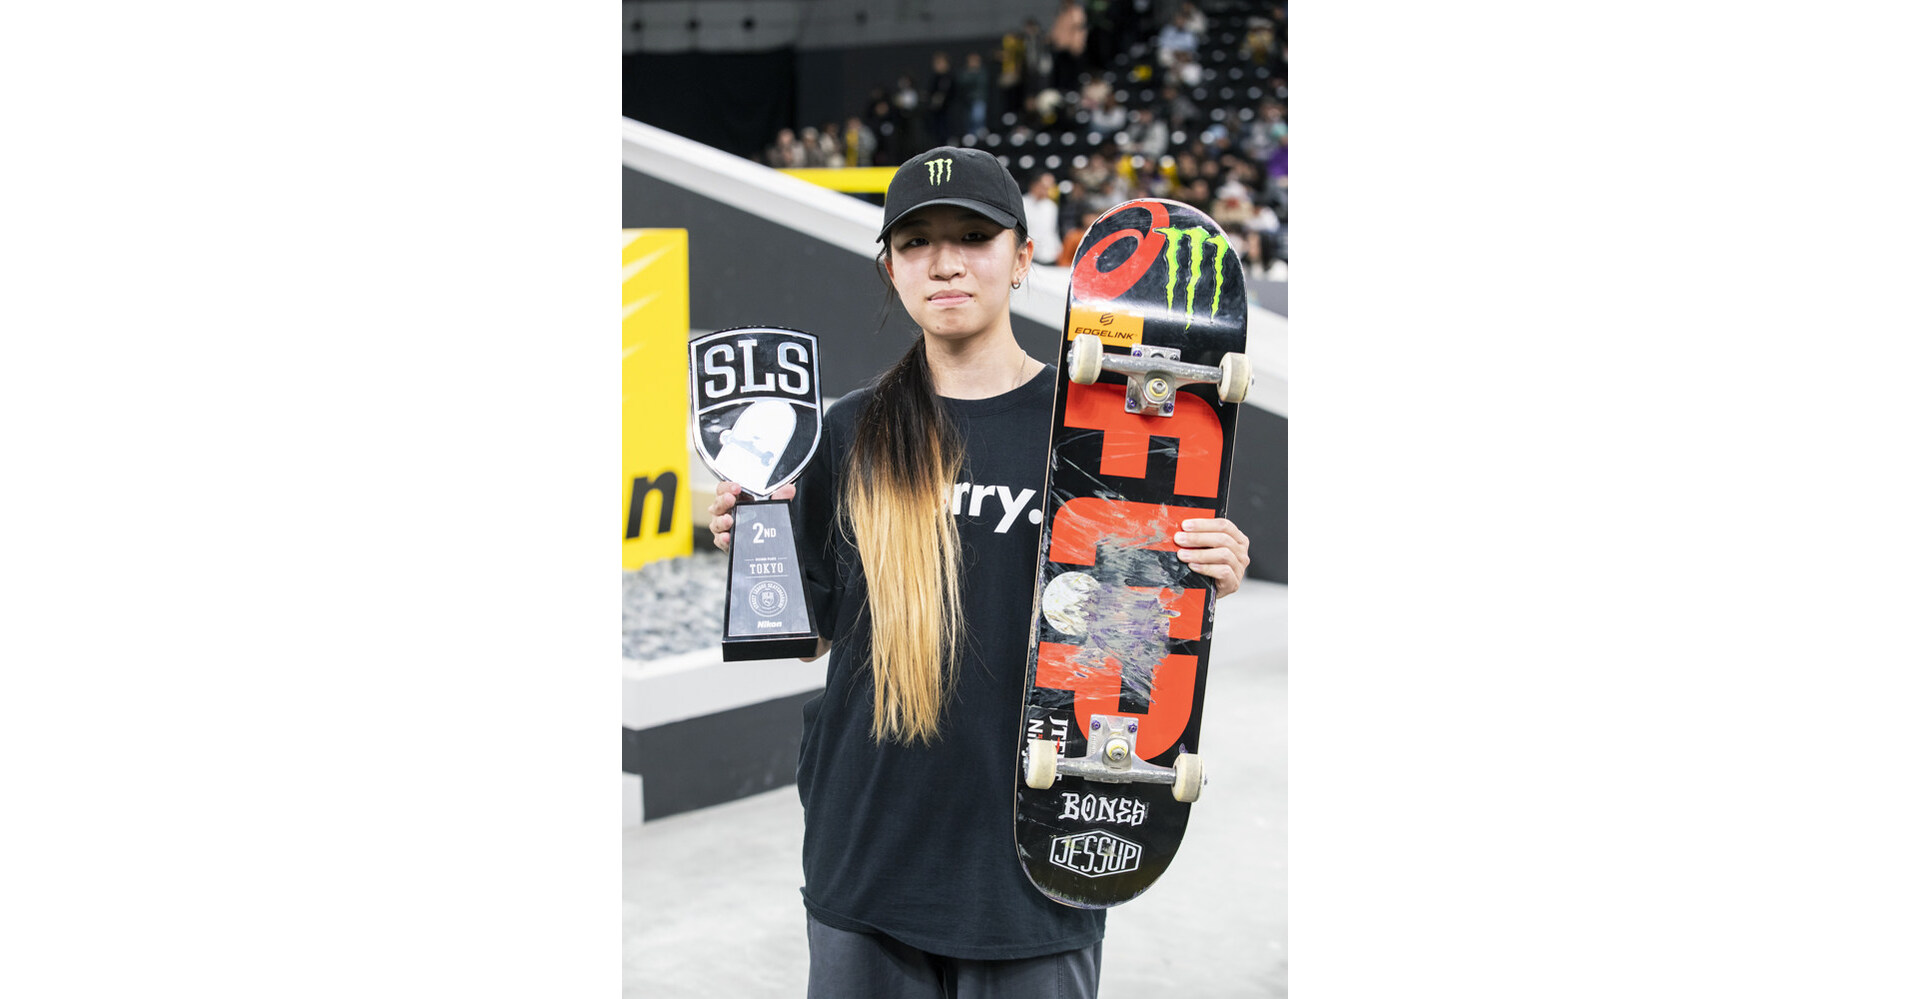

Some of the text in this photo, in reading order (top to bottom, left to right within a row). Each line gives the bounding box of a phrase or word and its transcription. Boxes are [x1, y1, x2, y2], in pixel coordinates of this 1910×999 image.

[1074, 327, 1134, 340] EDGELINK
[704, 338, 810, 398] SLS
[945, 481, 1043, 534] rry.
[752, 522, 777, 544] 2ND
[749, 562, 783, 575] TOKYO
[757, 620, 782, 629] Nikon
[1058, 792, 1146, 826] BONES
[1055, 836, 1137, 874] JESSUP
